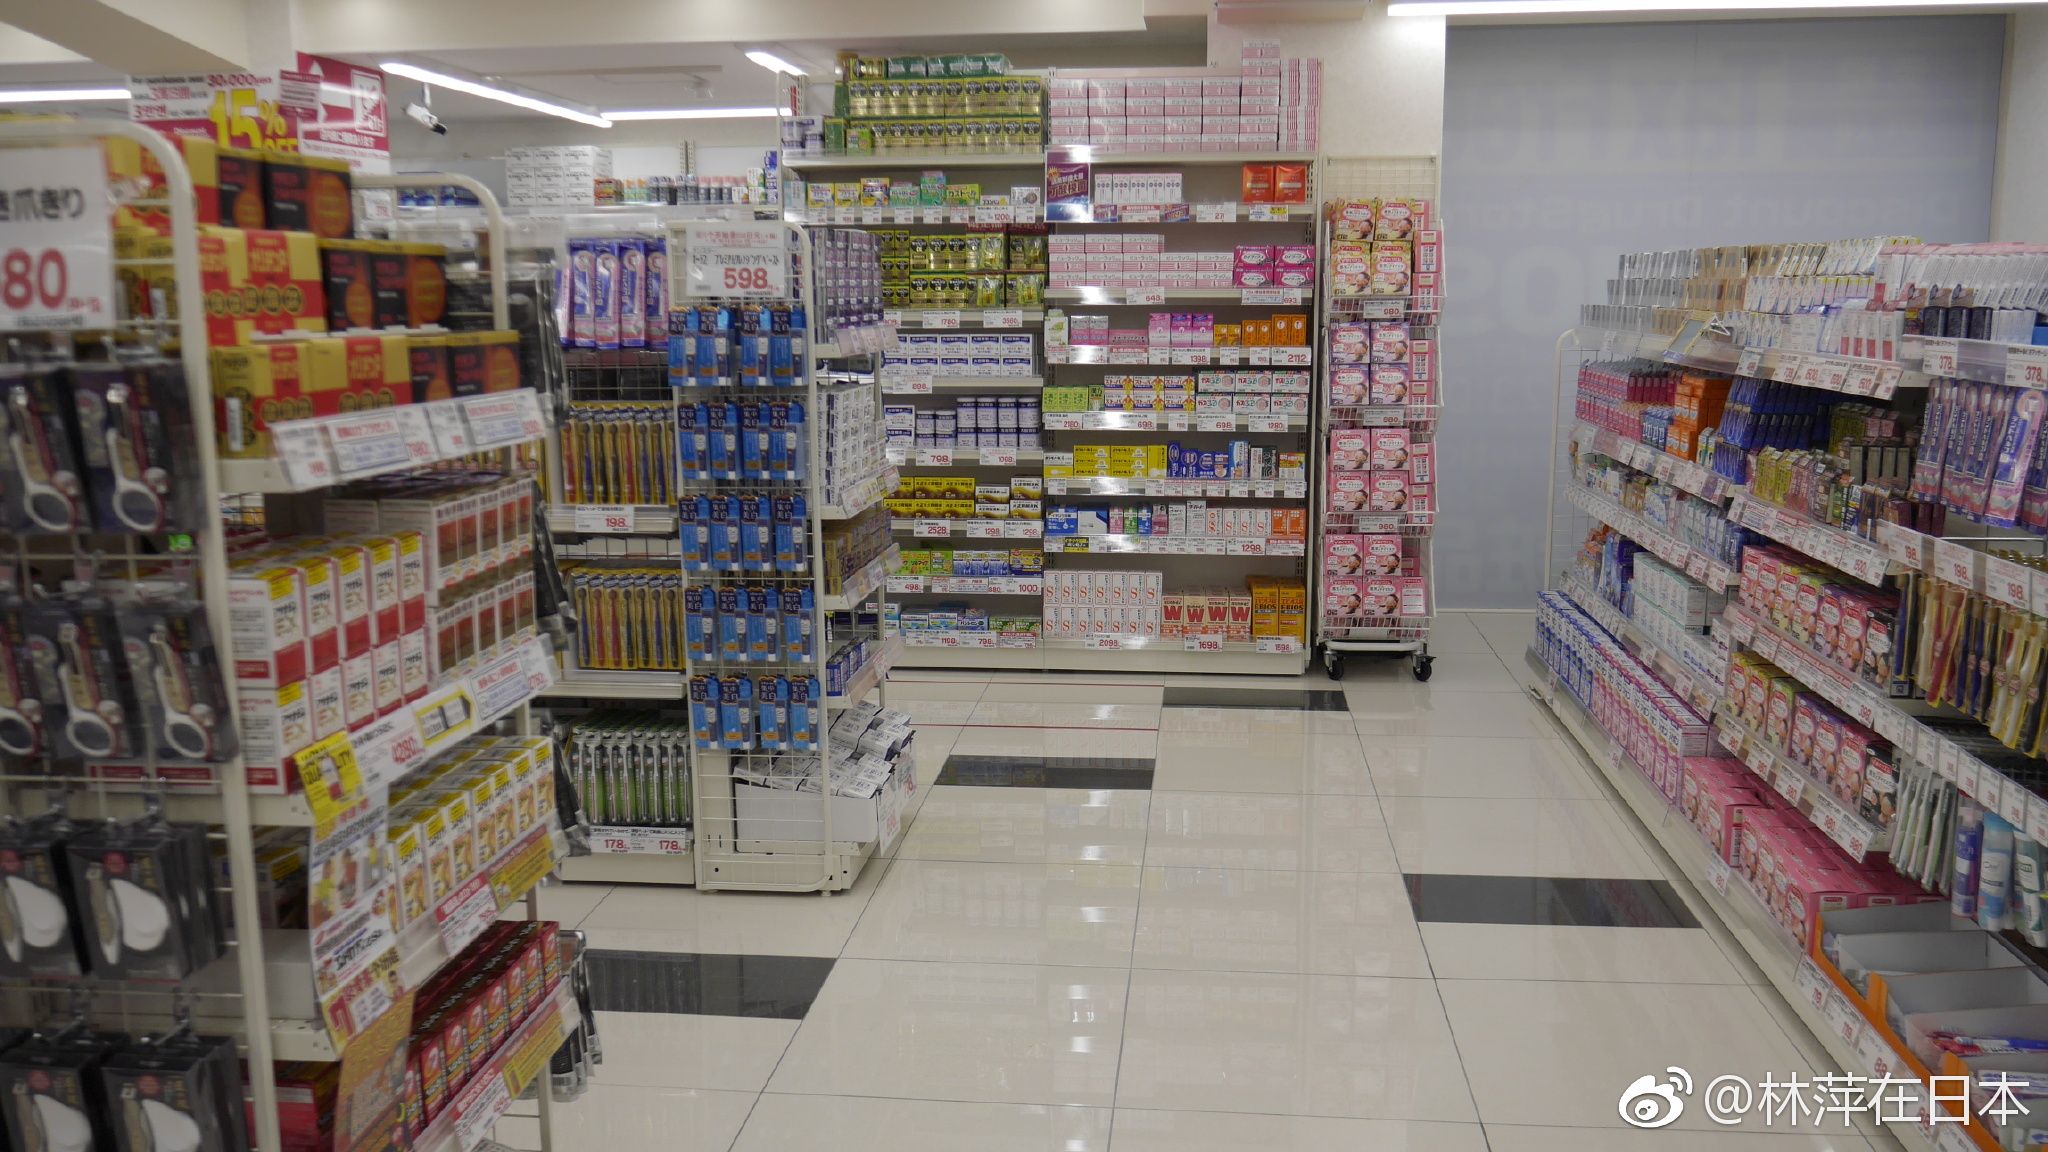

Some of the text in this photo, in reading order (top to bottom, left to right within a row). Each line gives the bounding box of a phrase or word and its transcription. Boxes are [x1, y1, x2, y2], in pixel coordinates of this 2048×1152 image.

[724, 267, 768, 290] 598
[1287, 354, 1307, 363] 2112
[2025, 366, 2041, 382] 378
[931, 454, 949, 463] 798
[604, 517, 627, 528] 198
[1226, 522, 1233, 532] S
[1241, 522, 1248, 532] S
[1257, 522, 1264, 532] S
[1241, 544, 1261, 552] 1298
[1905, 544, 1917, 561] 198
[1953, 563, 1967, 579] 198
[1018, 584, 1038, 593] 1000
[1046, 586, 1053, 597] S
[1063, 586, 1070, 598] S
[1080, 586, 1087, 598] S
[1097, 587, 1104, 598] S
[1113, 587, 1121, 599] S
[1130, 587, 1138, 599] S
[1147, 588, 1155, 599] S
[2007, 582, 2023, 599] 198
[1163, 605, 1182, 620] W
[1186, 609, 1204, 622] W
[1208, 606, 1227, 621] W
[1231, 606, 1250, 621] W
[1046, 620, 1053, 631] S
[1062, 620, 1070, 632] S
[1079, 620, 1087, 632] S
[1096, 621, 1103, 633] S
[1112, 621, 1120, 633] S
[1129, 622, 1137, 633] S
[1146, 622, 1154, 633] S
[1099, 639, 1118, 647] 2098
[1198, 641, 1218, 650] 1698
[604, 839, 624, 849] 178
[659, 840, 679, 851] 178
